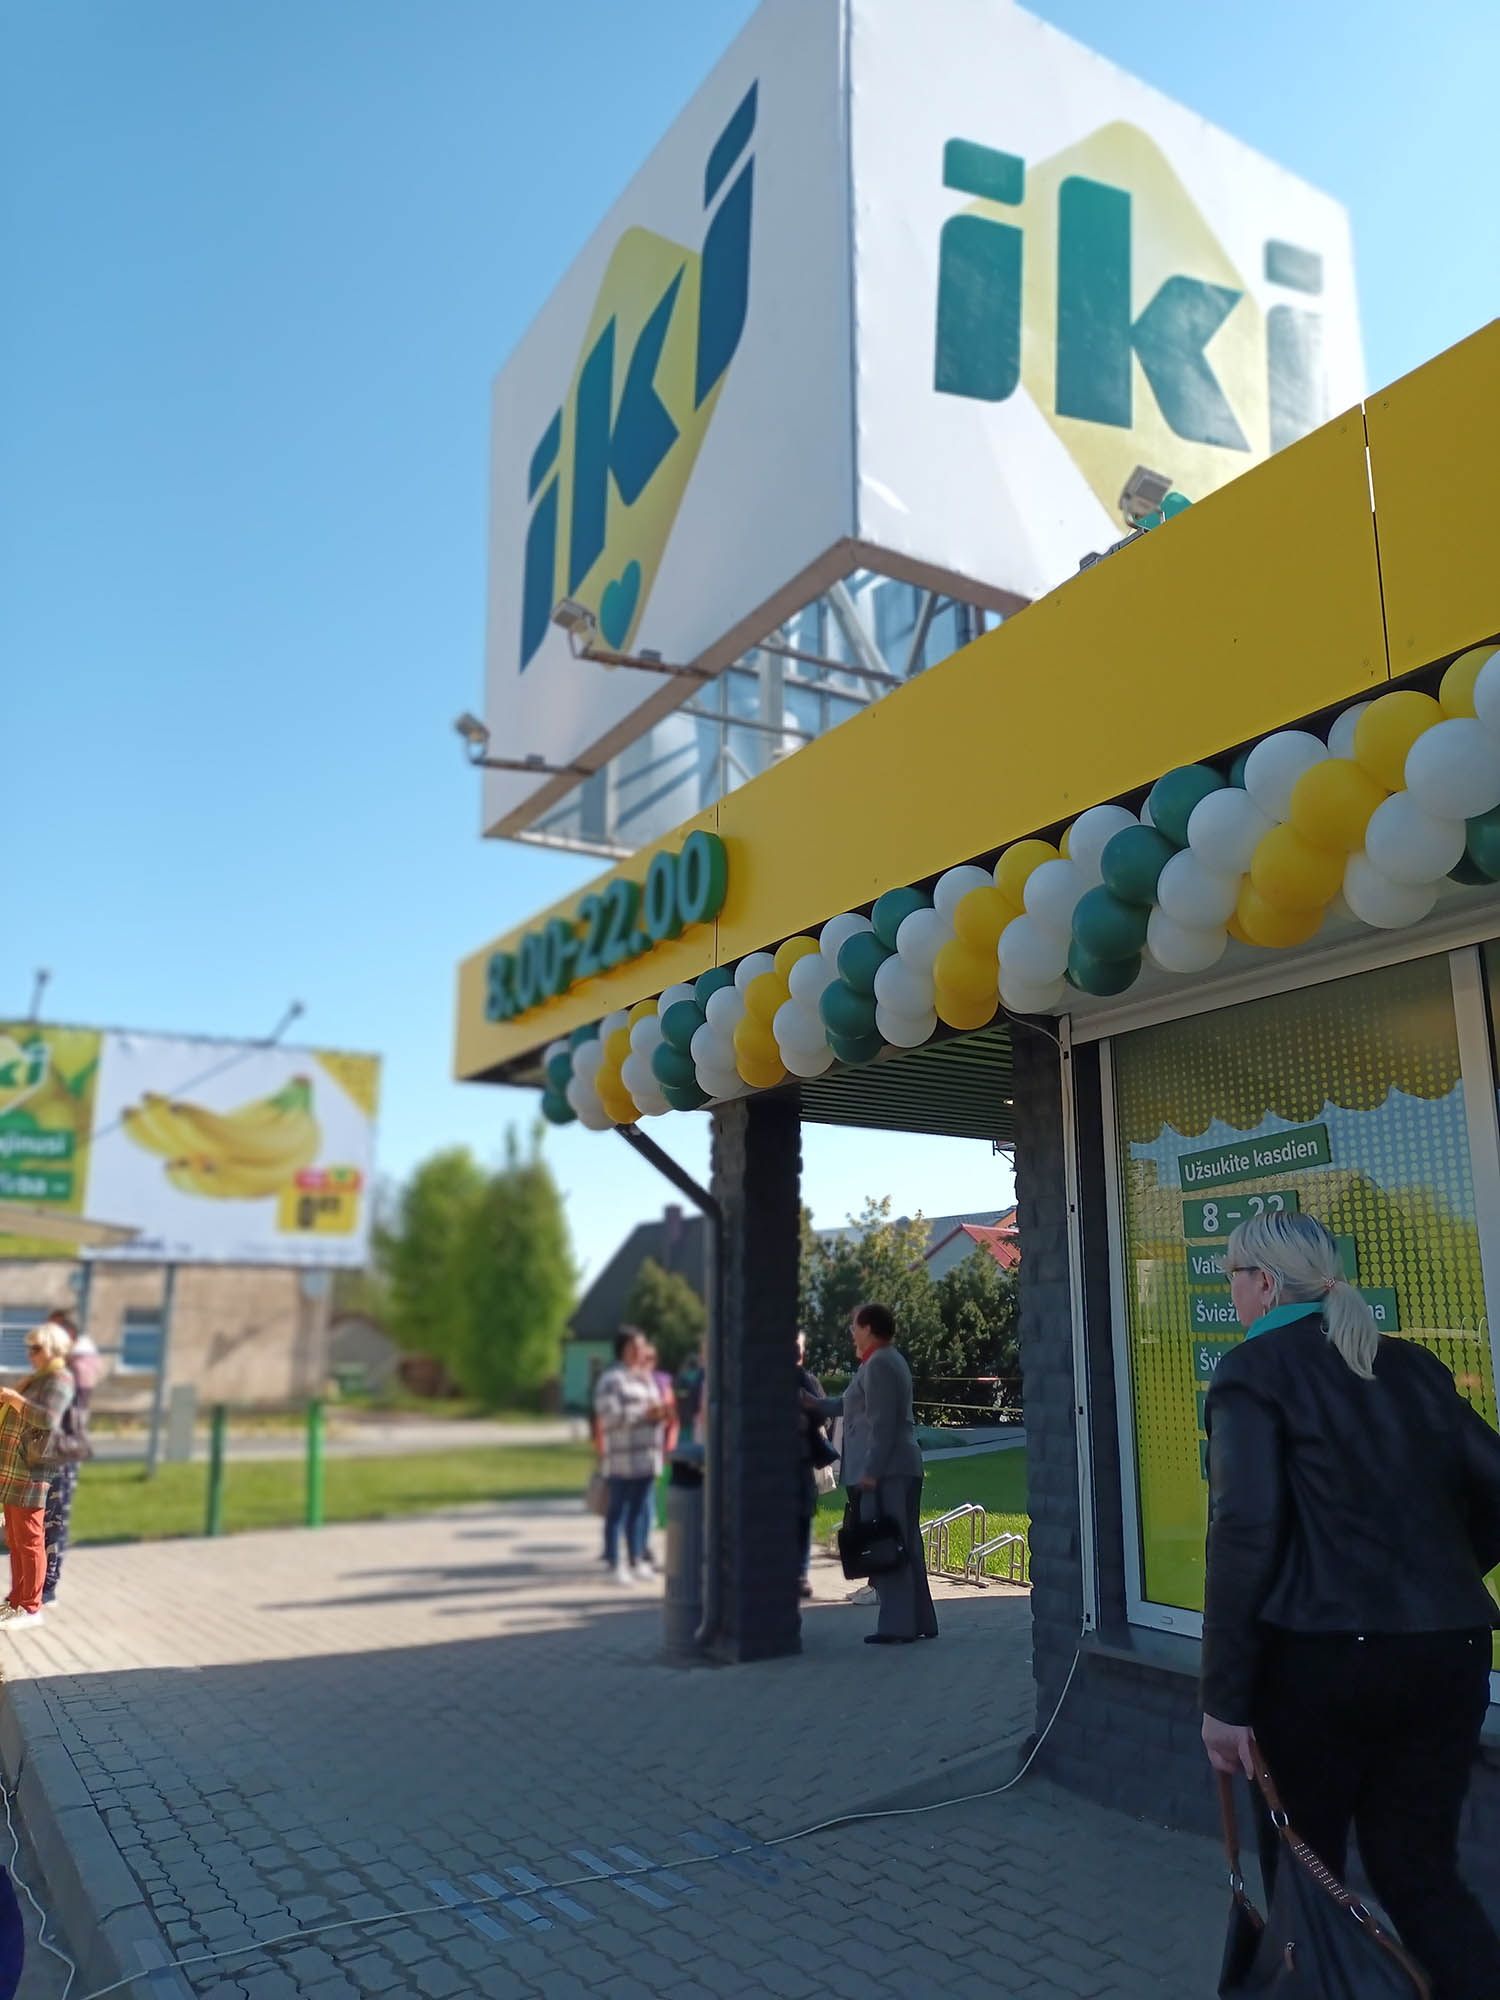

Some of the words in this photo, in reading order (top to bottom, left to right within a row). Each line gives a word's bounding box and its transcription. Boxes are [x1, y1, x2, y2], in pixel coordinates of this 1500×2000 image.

[517, 78, 759, 674] iki
[933, 137, 1325, 455] iki
[1184, 1153, 1250, 1181] Užsukite
[1253, 1139, 1318, 1167] kasdien
[1203, 1202, 1219, 1233] 8
